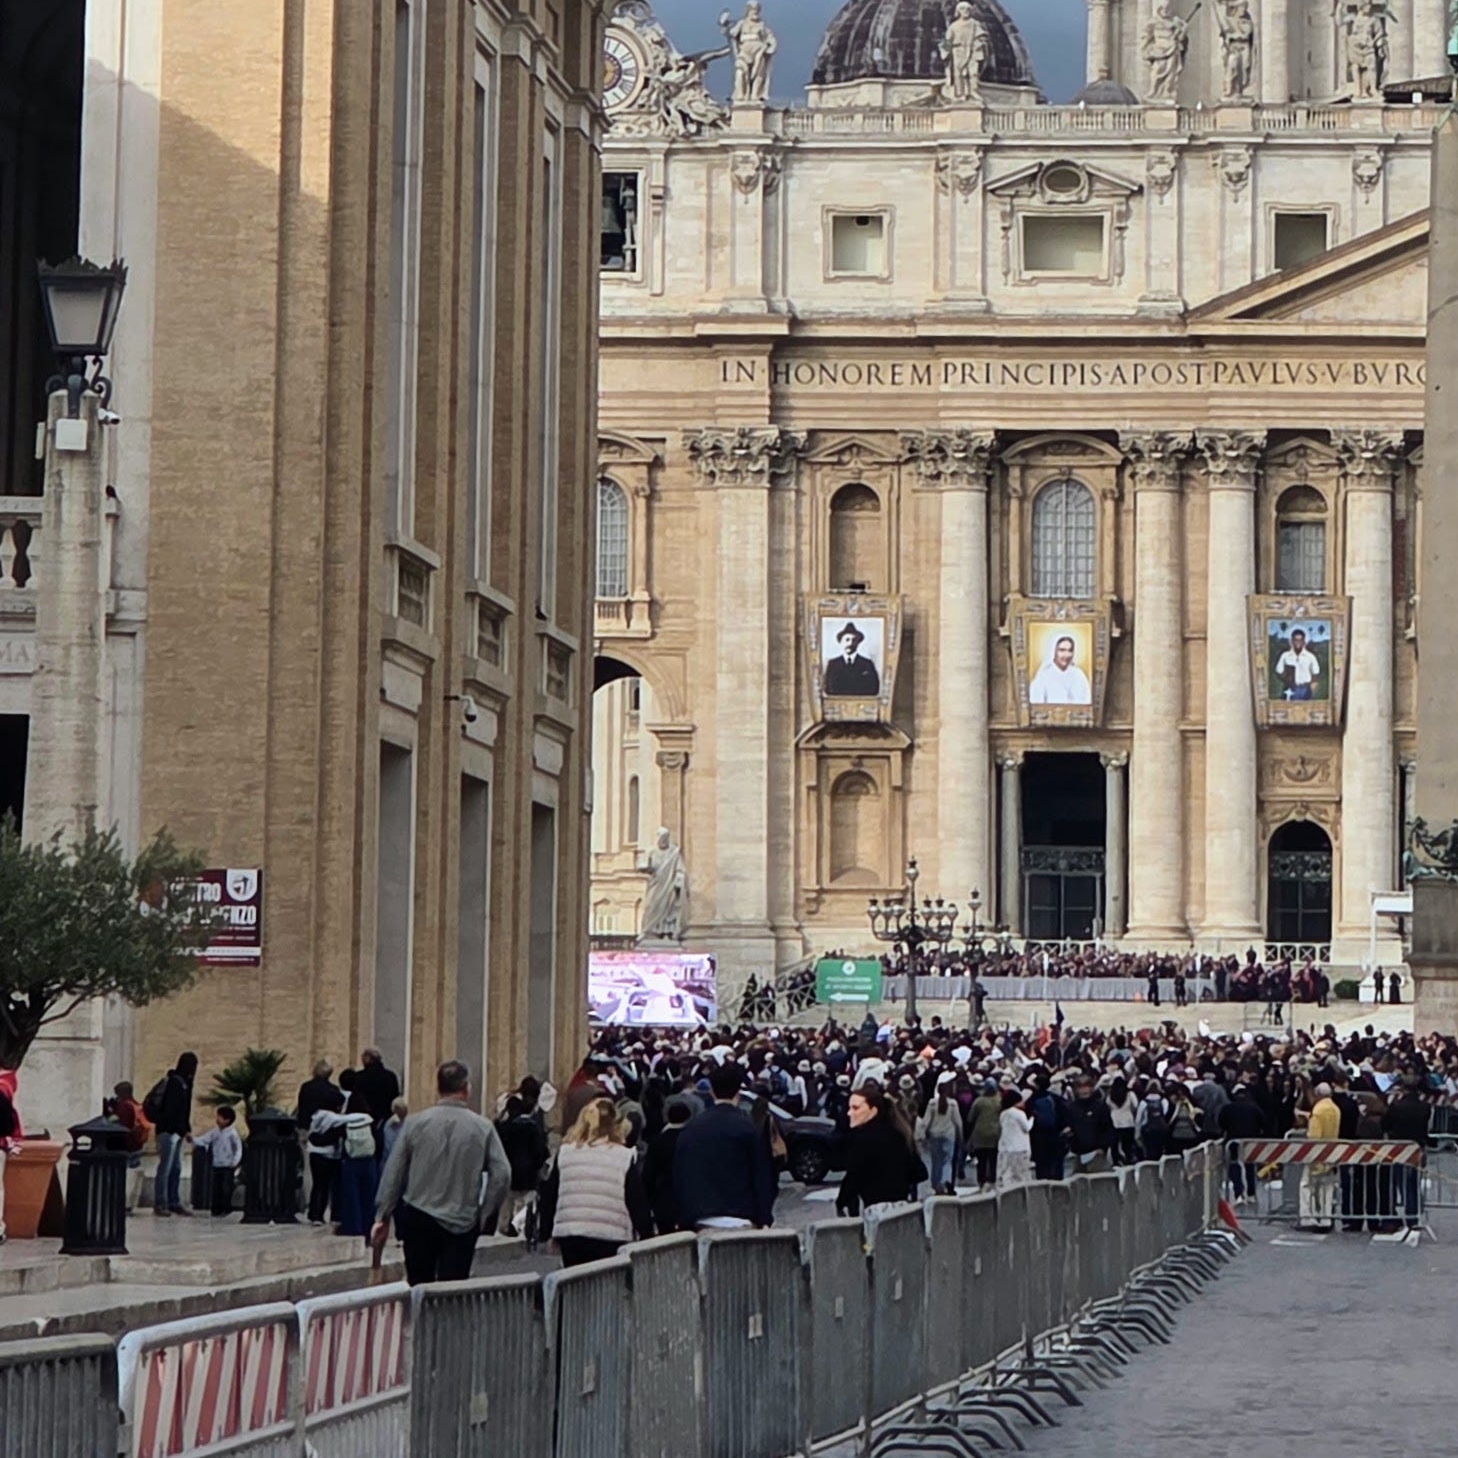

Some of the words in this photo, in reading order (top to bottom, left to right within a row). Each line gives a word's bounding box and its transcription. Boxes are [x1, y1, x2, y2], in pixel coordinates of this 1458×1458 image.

[722, 360, 756, 383] IN
[773, 362, 932, 386] HONOREM
[943, 362, 1102, 386] PRINCIPIS
[1109, 362, 1208, 386] APOST
[1213, 361, 1318, 386] PAVLVS
[1326, 362, 1346, 386] V
